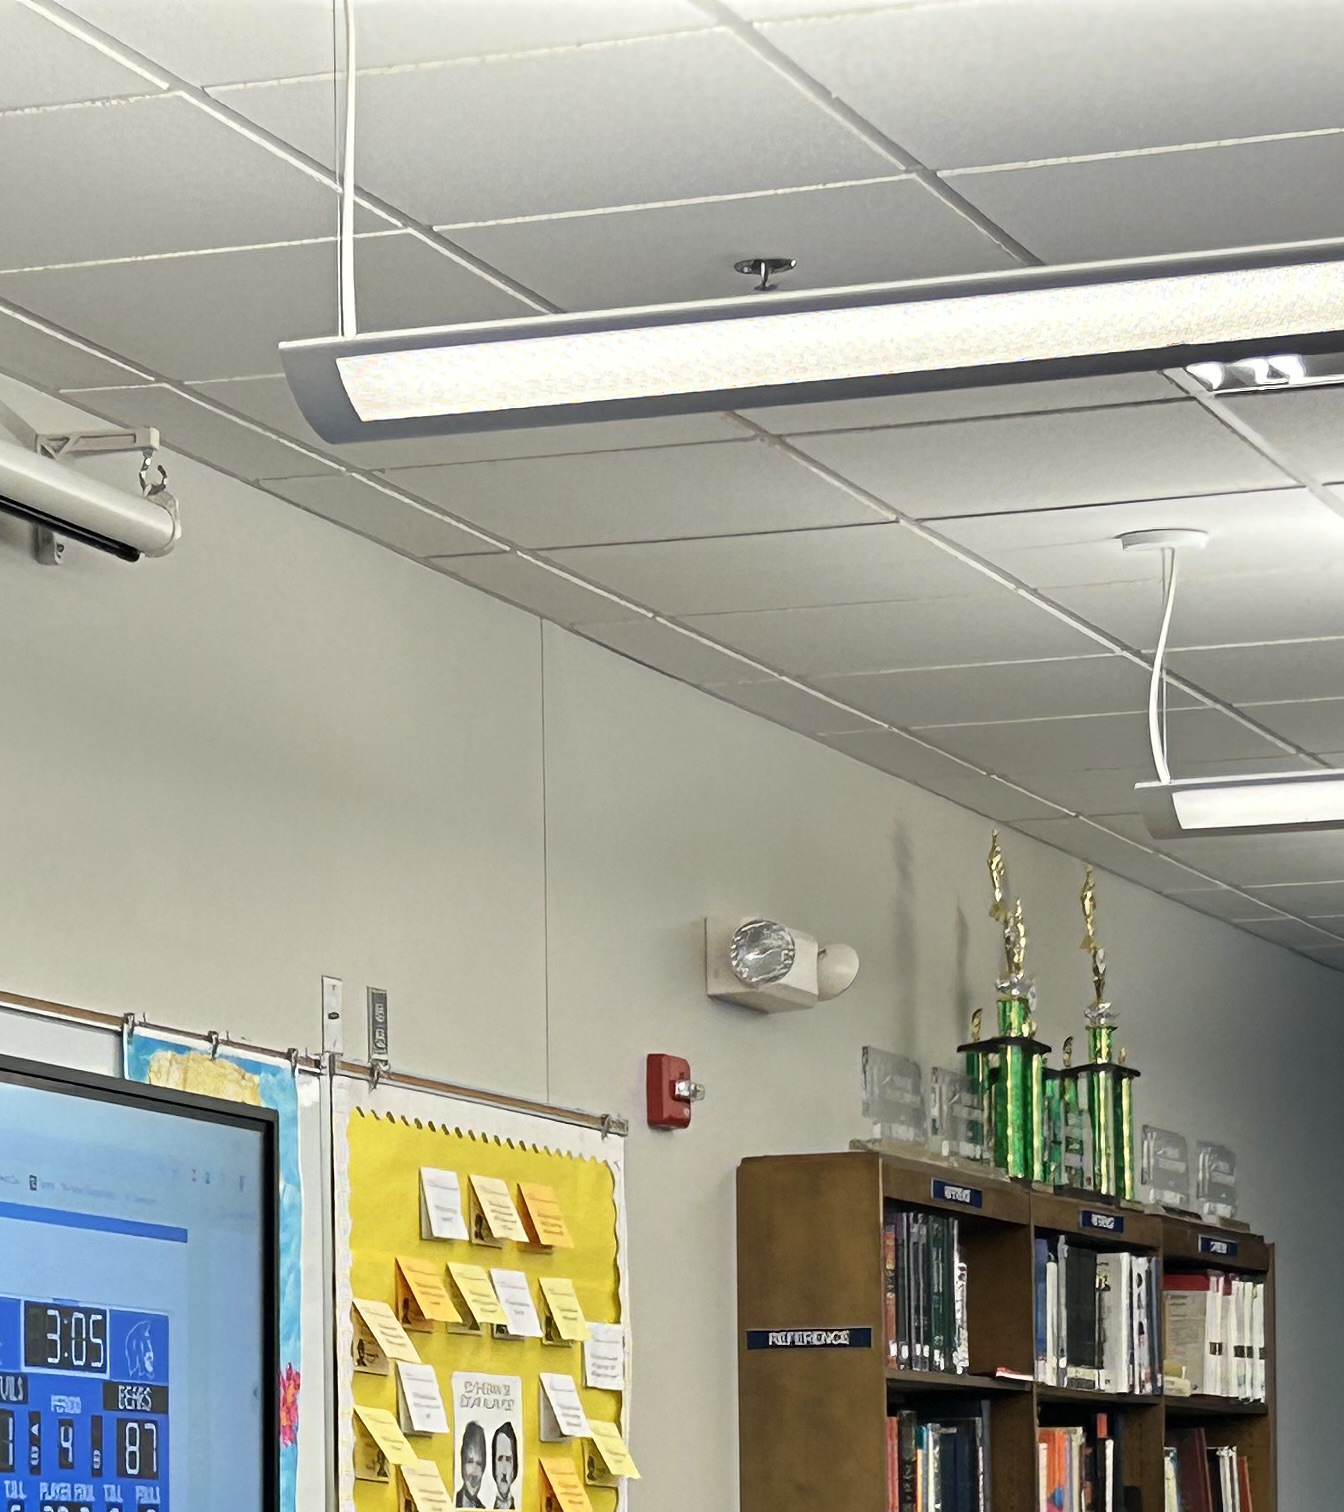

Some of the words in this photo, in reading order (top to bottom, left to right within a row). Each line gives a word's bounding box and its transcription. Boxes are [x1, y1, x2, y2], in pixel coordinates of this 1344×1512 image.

[46, 1309, 103, 1367] 3:05
[769, 1330, 850, 1346] REFERENCE
[60, 1426, 73, 1463] 4
[125, 1422, 157, 1476] 87
